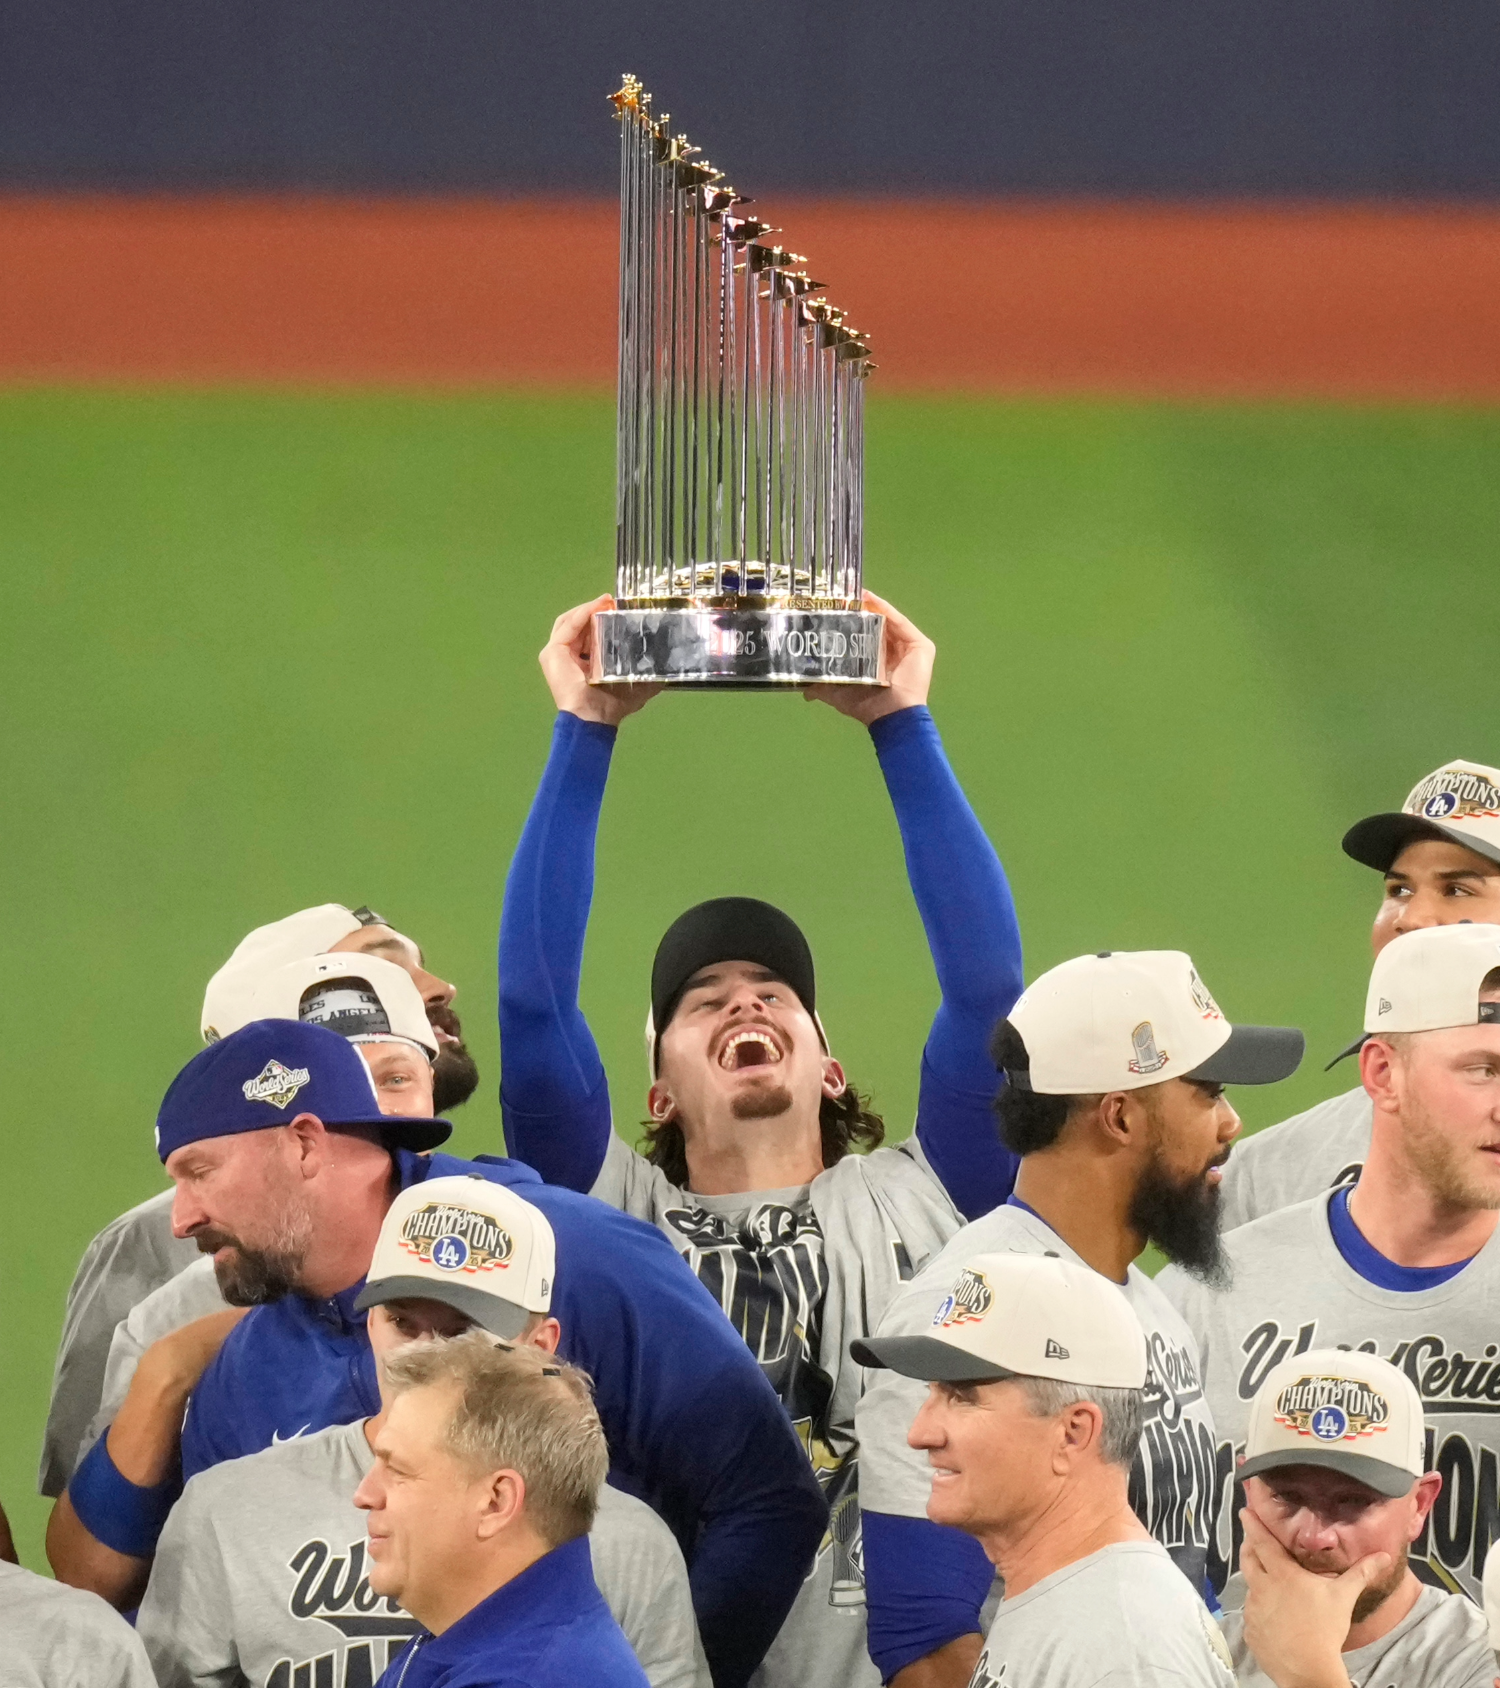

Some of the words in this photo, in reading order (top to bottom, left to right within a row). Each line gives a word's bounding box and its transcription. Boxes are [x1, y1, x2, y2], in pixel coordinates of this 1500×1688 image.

[762, 629, 848, 658] WORLD
[1428, 795, 1449, 817] LA
[242, 1074, 280, 1098] World
[404, 1211, 510, 1259] CHAMPIONS
[437, 1238, 460, 1267] LA
[1279, 1384, 1386, 1423] CHAMPIONS
[1317, 1409, 1339, 1436] LA
